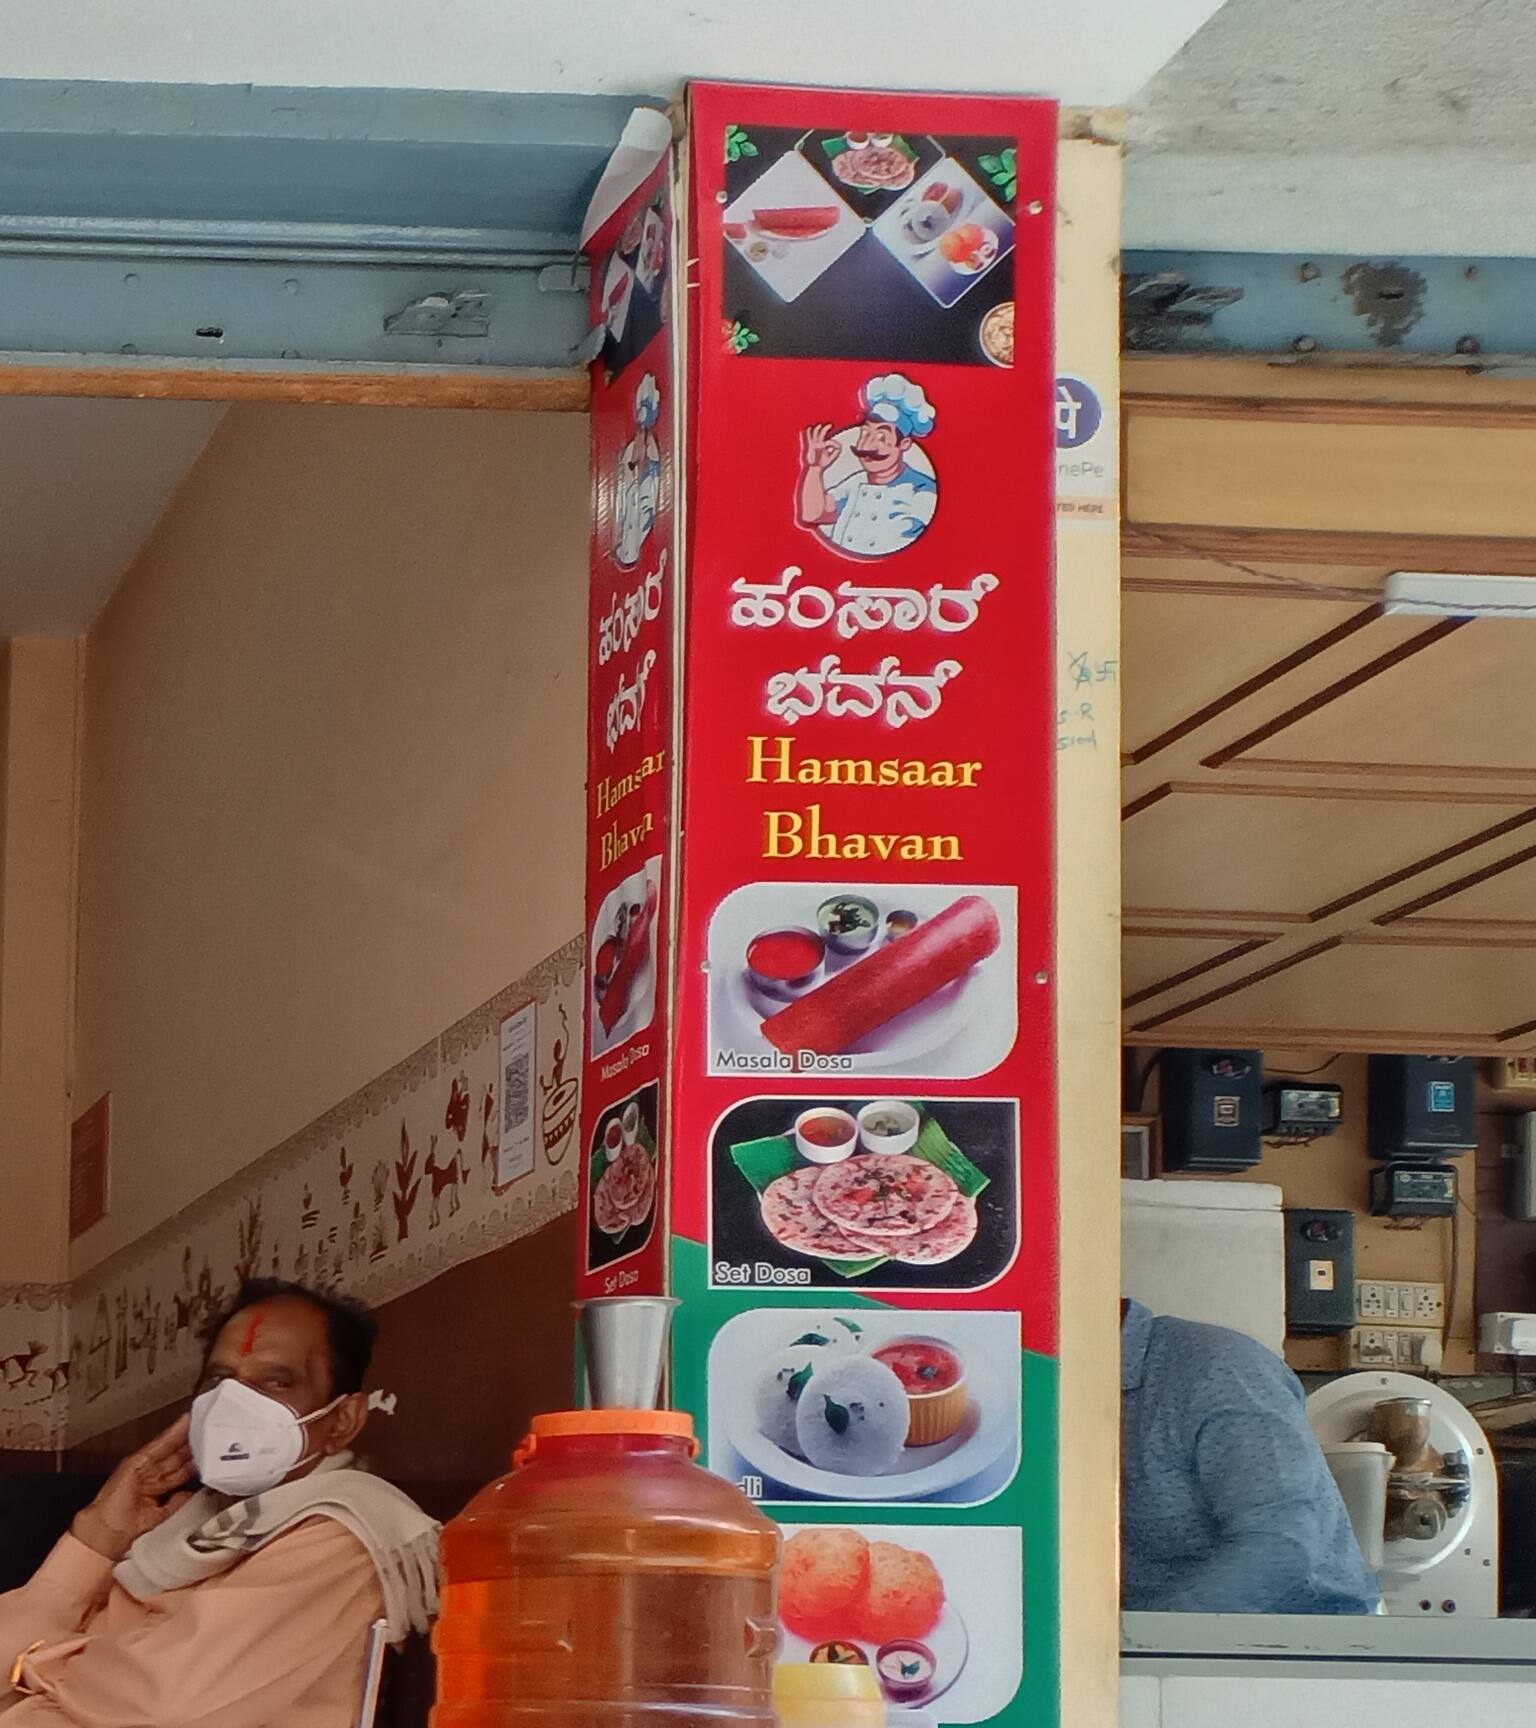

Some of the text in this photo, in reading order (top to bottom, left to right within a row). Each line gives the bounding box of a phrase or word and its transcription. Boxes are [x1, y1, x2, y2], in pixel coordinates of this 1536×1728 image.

[1057, 461, 1104, 479] nePe
[745, 735, 983, 788] Hamsaar
[596, 749, 666, 820] Hamsar
[599, 812, 654, 872] Bhavn
[762, 803, 964, 862] Bhavan
[715, 1049, 854, 1070] Masala Dosa
[715, 1261, 812, 1285] Set Dosa
[736, 1475, 763, 1498] dli
